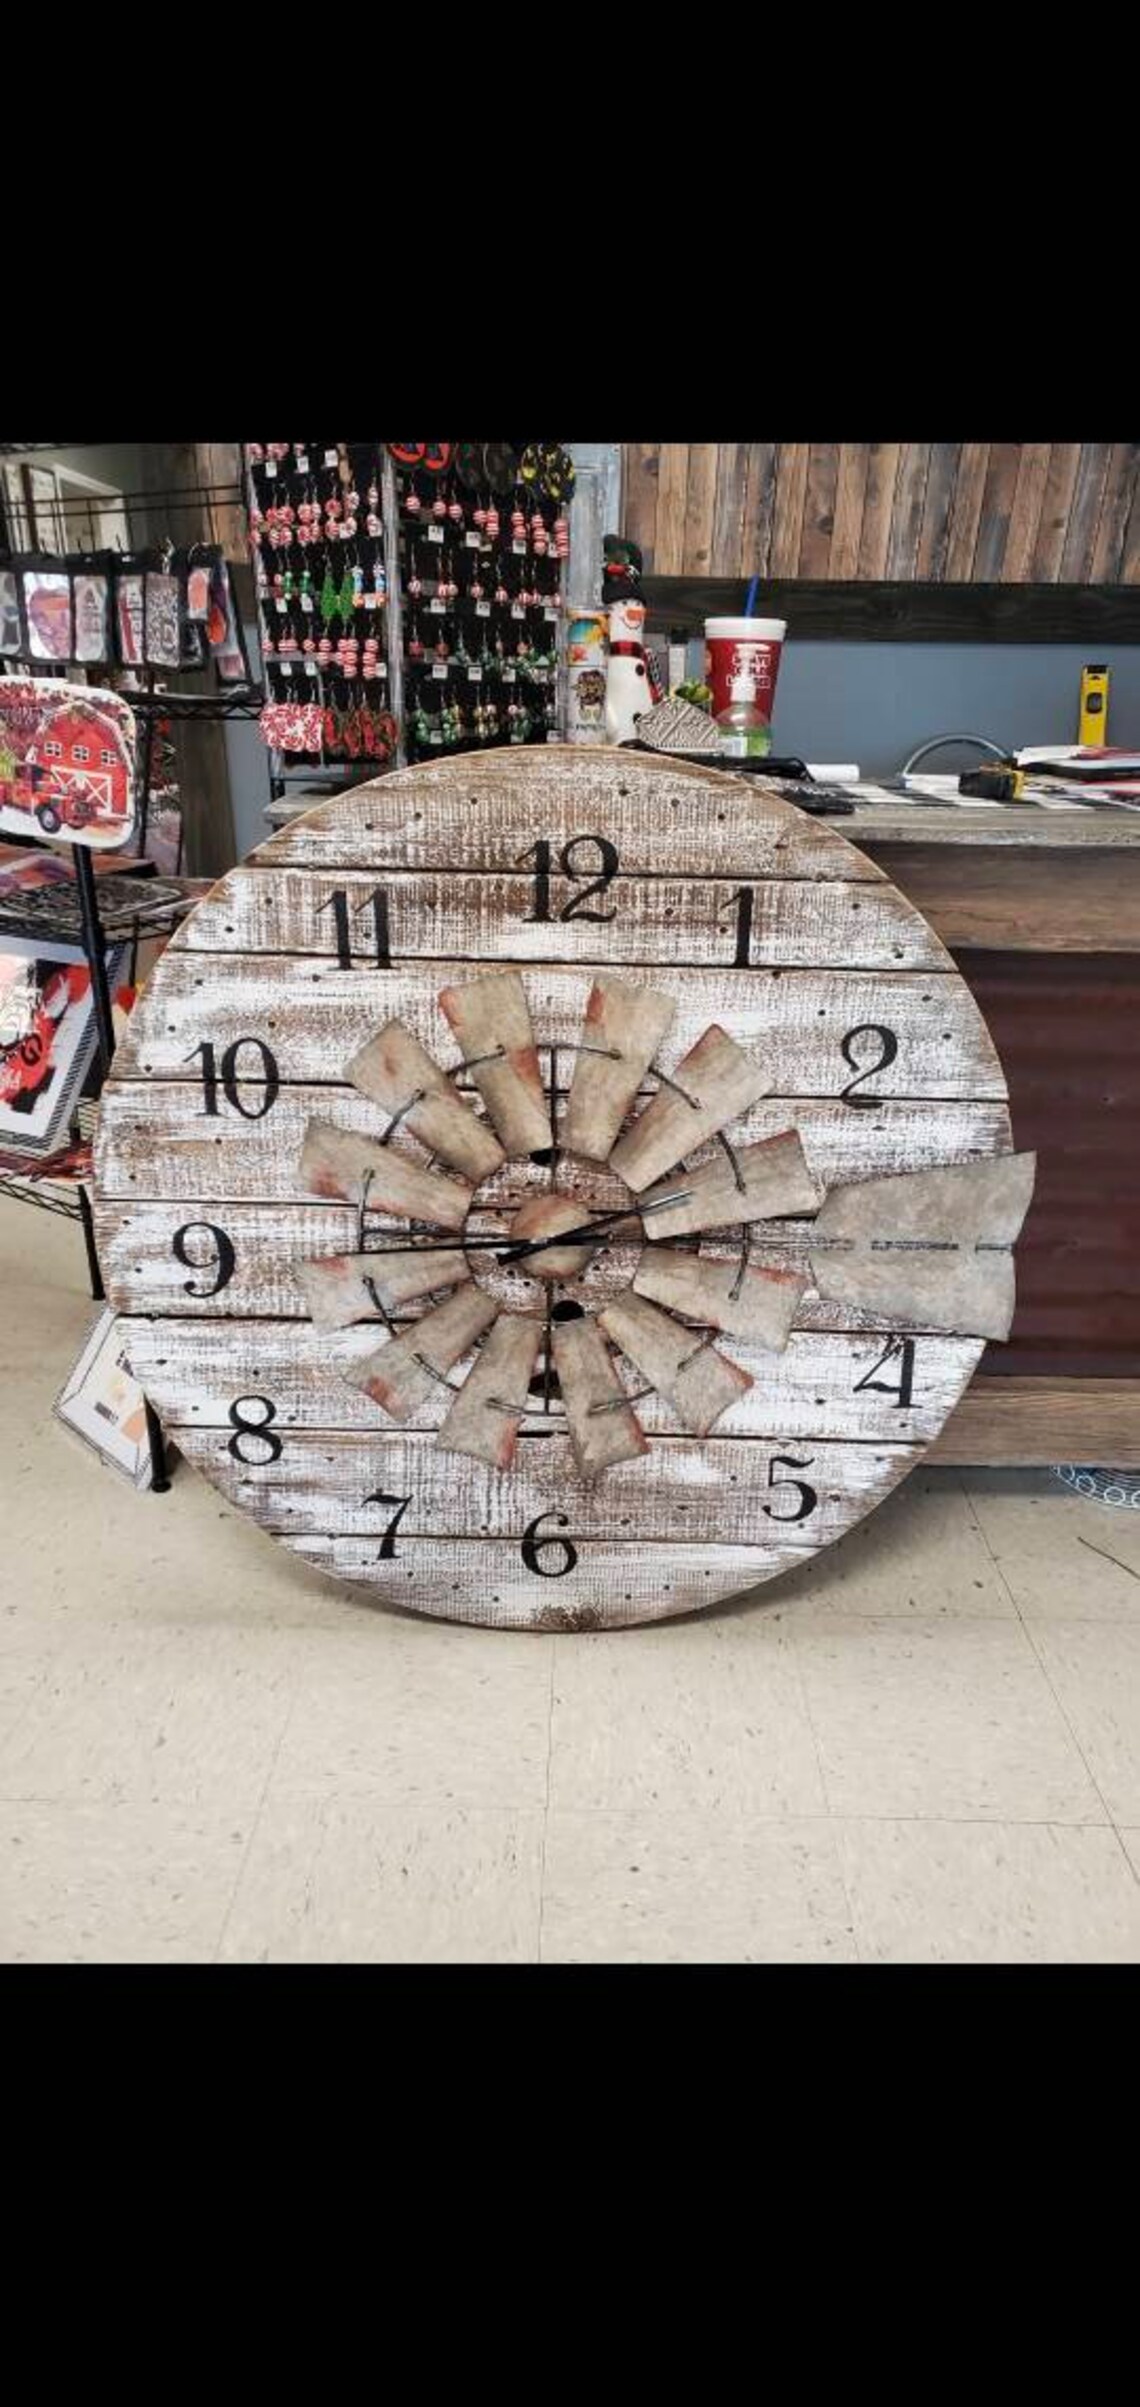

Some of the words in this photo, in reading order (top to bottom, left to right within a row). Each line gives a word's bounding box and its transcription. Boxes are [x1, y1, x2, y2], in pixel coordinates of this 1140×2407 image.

[523, 836, 619, 923] 12
[320, 889, 394, 970] 11
[728, 888, 758, 969] 1
[184, 1037, 280, 1119] 10
[842, 1024, 897, 1109] 2
[172, 1222, 236, 1298] 9
[854, 1333, 917, 1409] 4
[228, 1395, 283, 1465] 8
[361, 1494, 412, 1560] 7
[763, 1456, 817, 1522] 5
[522, 1512, 578, 1578] 6
